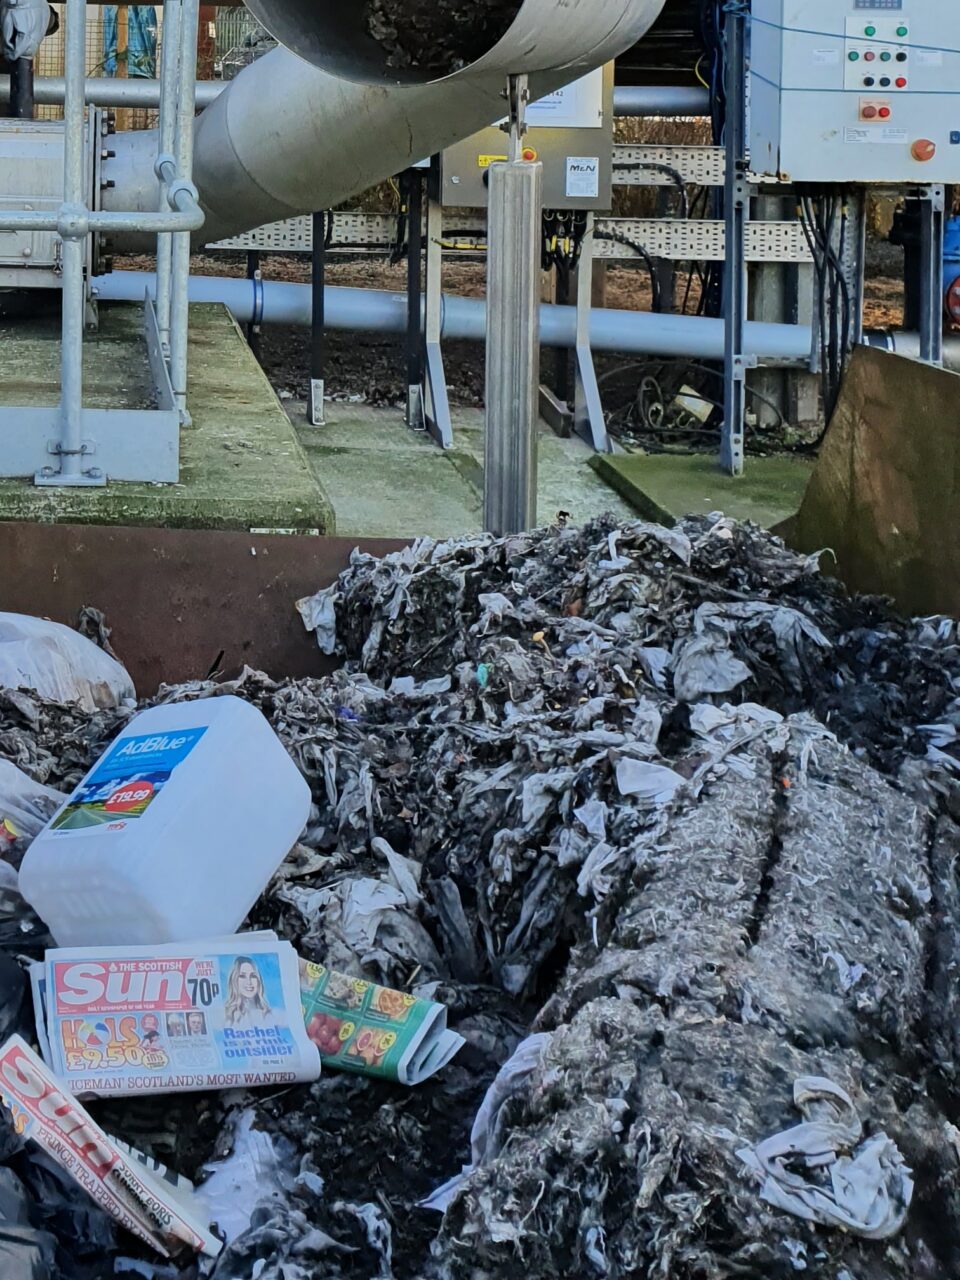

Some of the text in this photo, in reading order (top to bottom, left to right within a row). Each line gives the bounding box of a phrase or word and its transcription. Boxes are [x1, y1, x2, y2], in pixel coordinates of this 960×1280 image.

[115, 735, 187, 757] AdBlue
[107, 789, 151, 804] £19.99
[120, 961, 183, 972] THE SCOTTISH
[58, 963, 184, 1005] Sun
[187, 977, 220, 1007] 70p
[223, 1025, 281, 1039] Rachel
[66, 1047, 145, 1071] £9.50
[224, 1045, 293, 1058] outsider
[128, 1074, 204, 1088] SCOTLAND'S
[206, 1073, 240, 1086] MOST
[244, 1071, 297, 1084] WANTED
[37, 1128, 76, 1168] PRINCE
[74, 1163, 121, 1218] TRAPPED
[146, 1197, 174, 1226] BORIS
